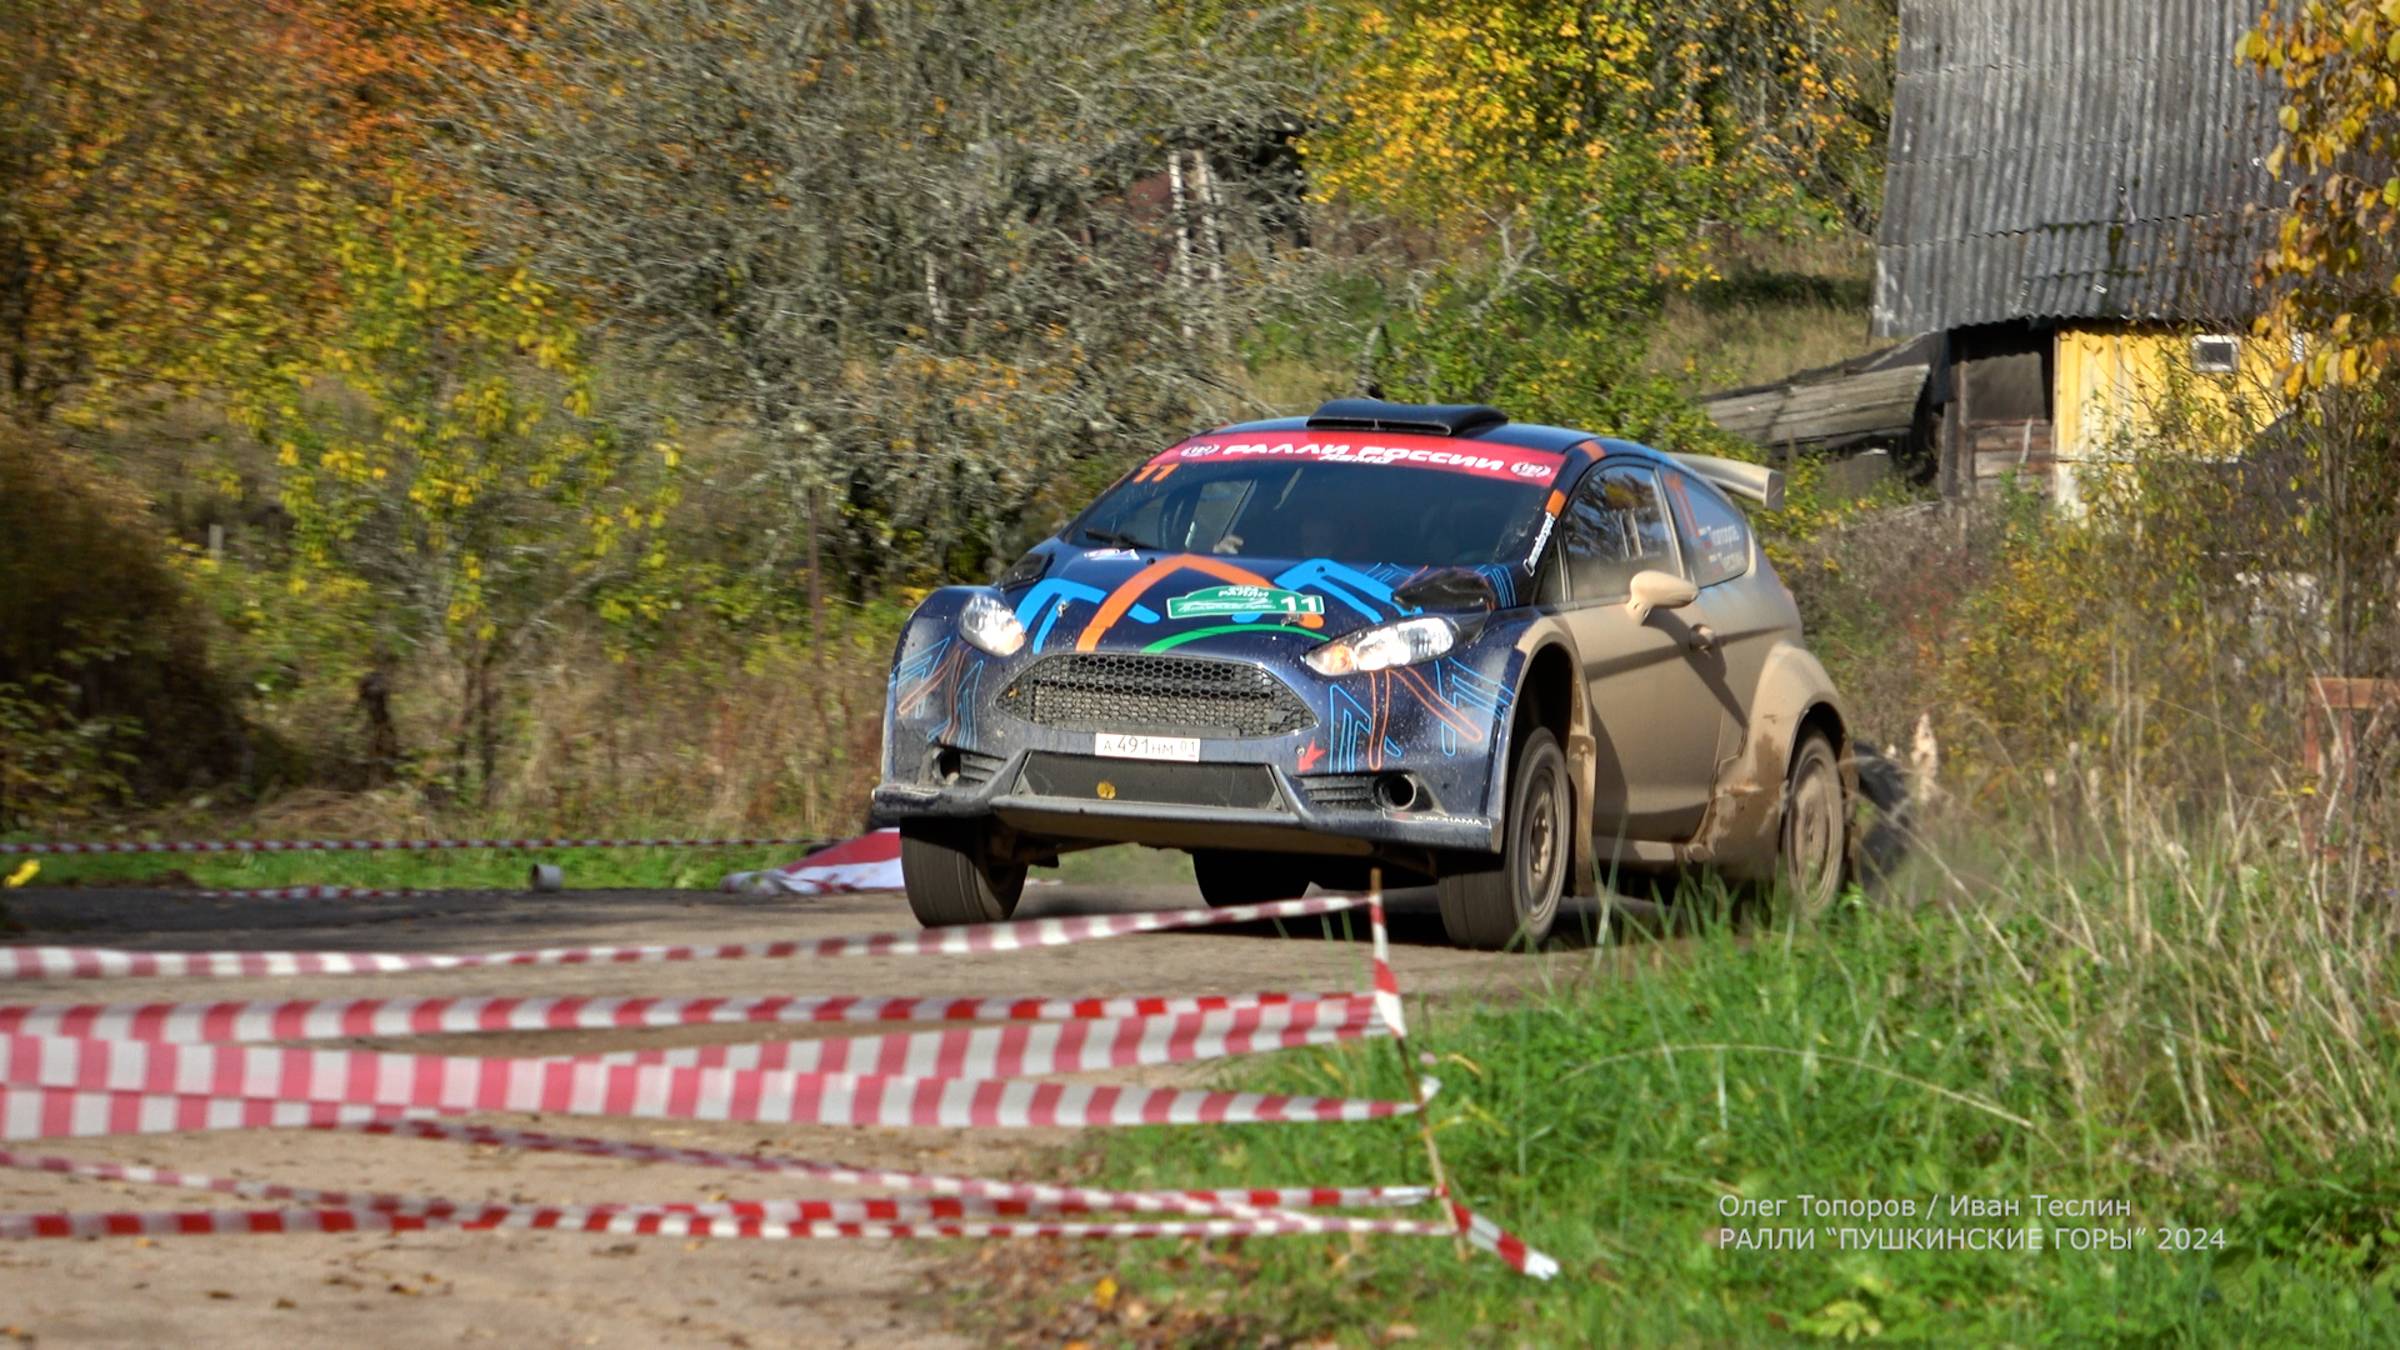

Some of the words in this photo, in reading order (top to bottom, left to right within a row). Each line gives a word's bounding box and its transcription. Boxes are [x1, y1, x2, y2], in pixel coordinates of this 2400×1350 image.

[1222, 443, 1350, 456] РАЛЛИ
[1357, 445, 1505, 471] РОССИИ
[1132, 463, 1179, 484] 11
[1280, 596, 1317, 612] 11
